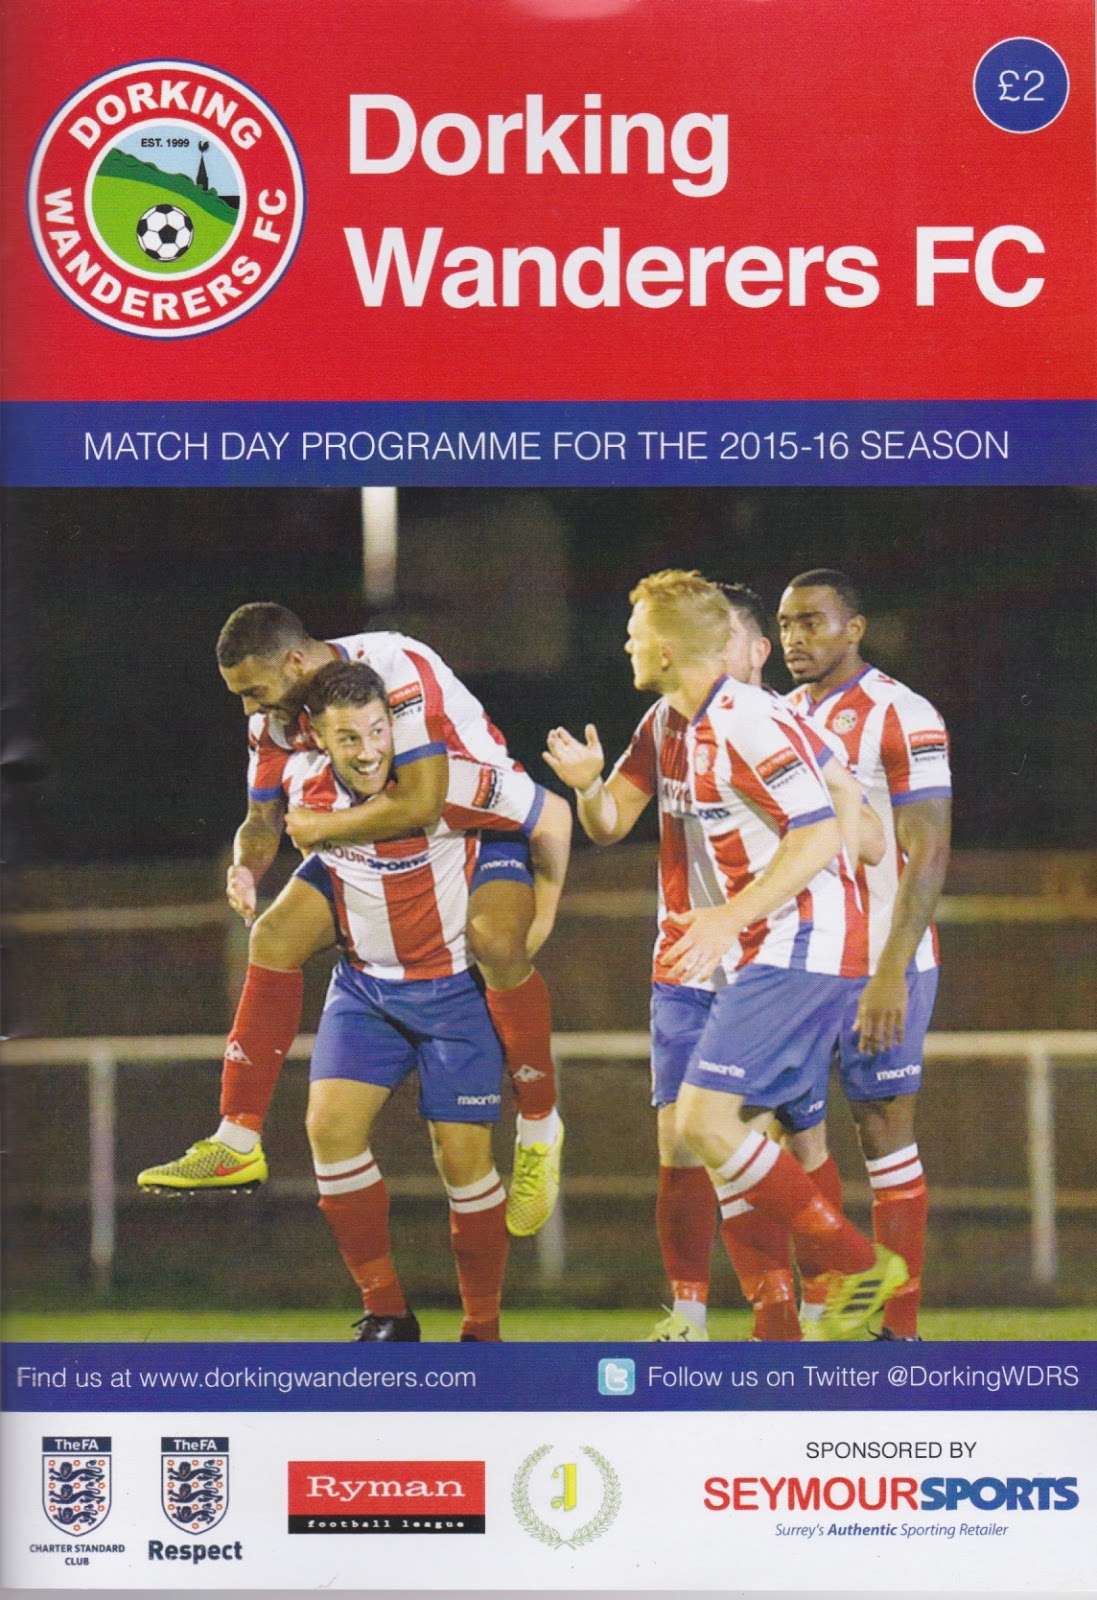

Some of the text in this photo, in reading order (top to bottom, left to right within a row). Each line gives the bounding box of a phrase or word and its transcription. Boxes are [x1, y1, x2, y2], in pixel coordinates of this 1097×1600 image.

[997, 70, 1046, 103] £2
[68, 79, 263, 151] DORKING
[140, 138, 190, 148] EST. 1999
[348, 93, 729, 198] Dorking
[43, 187, 288, 321] WANDERERS FC
[343, 225, 1046, 309] Wanderers FC
[84, 430, 1010, 462] MATCH DAY PROGRAMME FOR THE 2015-16 SEASON
[16, 1366, 477, 1393] Find us at www.dorkingwanderers.com
[648, 1365, 1080, 1391] Follow us on Twitter @DorkingWDRS
[806, 1442, 978, 1460] SPONSORED BY
[306, 1475, 466, 1502] Ryman
[307, 1520, 465, 1529] football league
[775, 1523, 1009, 1539] Surrey's Authentic Sporting Retailer
[29, 1544, 125, 1553] CHARTER STANDARD
[64, 1557, 90, 1566] CLUB
[148, 1540, 243, 1565] Respect
